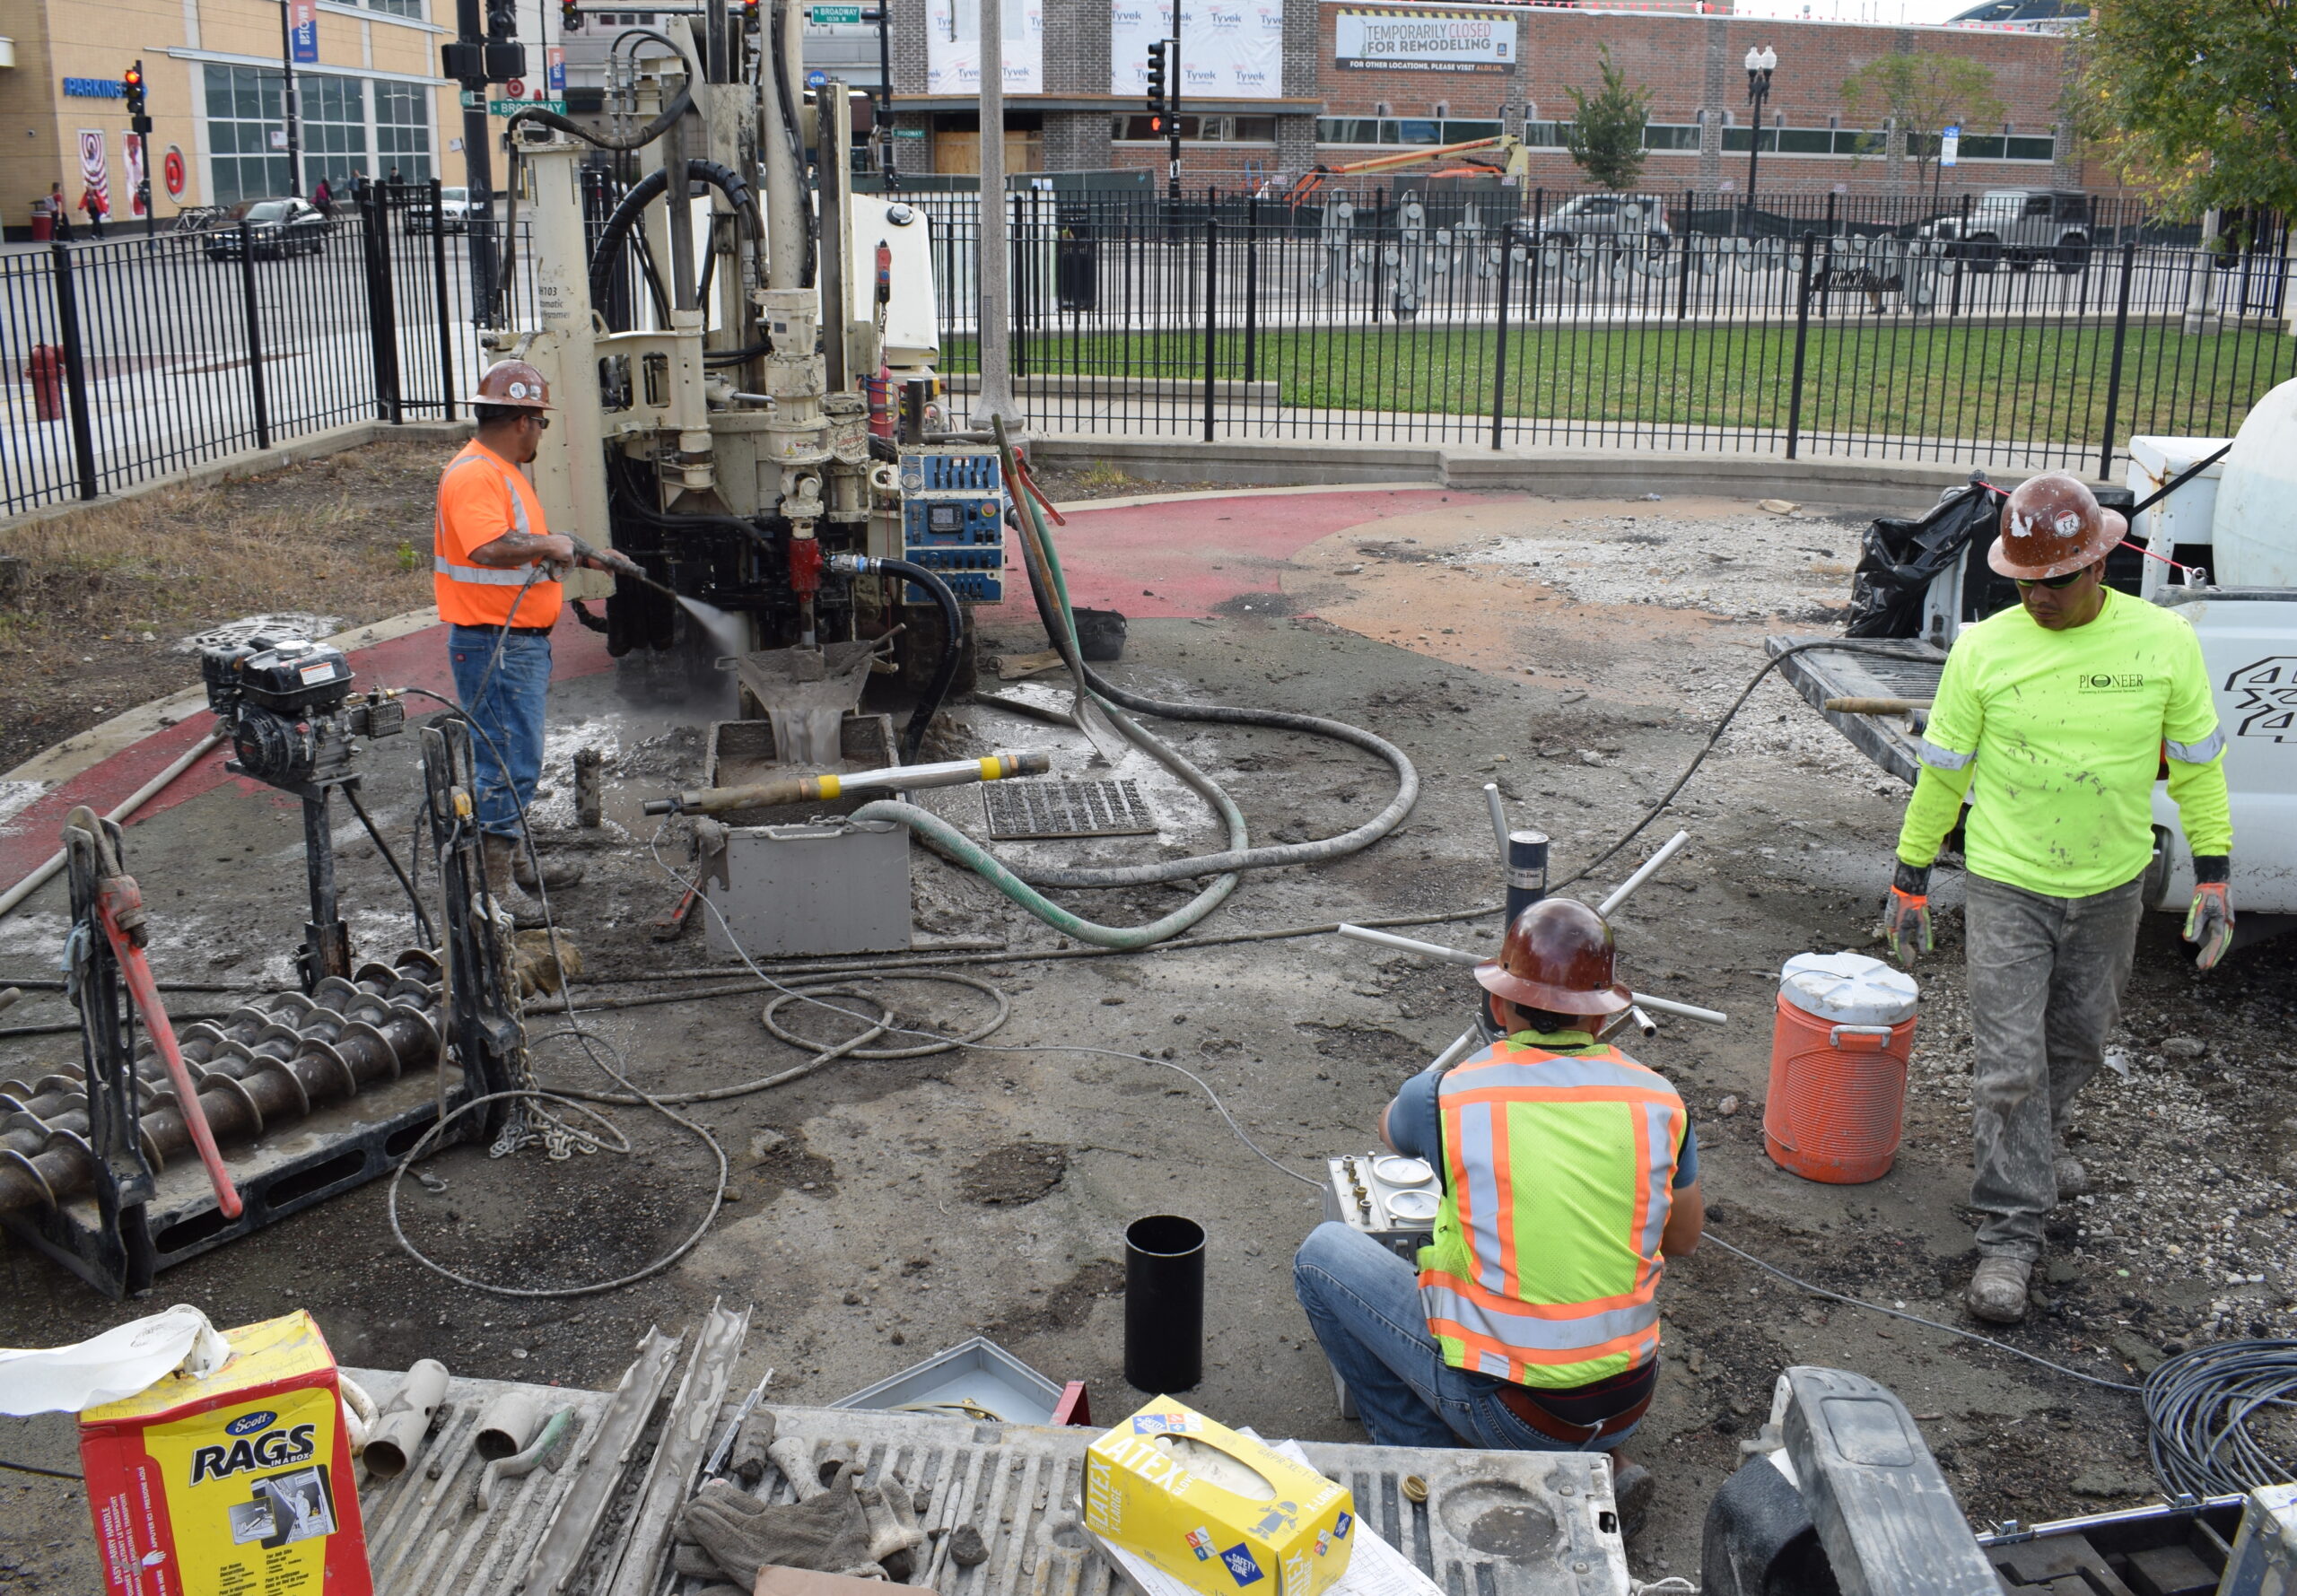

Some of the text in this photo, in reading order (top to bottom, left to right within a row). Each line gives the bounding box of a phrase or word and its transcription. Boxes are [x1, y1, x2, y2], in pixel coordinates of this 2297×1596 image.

[820, 7, 858, 16] BROADWAY
[1112, 11, 1141, 22] Tyvek
[1162, 12, 1192, 22] Tyek
[1212, 13, 1242, 23] Tyvek
[1367, 22, 1491, 40] TEMPORARILY CLOSED
[1367, 38, 1491, 53] FOR REMODELING
[1349, 60, 1364, 68] FOR
[1389, 62, 1429, 70] LOCATIONS,
[810, 75, 825, 83] cta
[1002, 67, 1030, 79] Tyvek
[1186, 70, 1216, 81] Tyvek
[1236, 71, 1265, 82] Tyvek
[64, 78, 124, 99] PARKING
[501, 102, 563, 114] BROWAY
[538, 285, 557, 296] H103
[2079, 674, 2144, 688] PIONEER
[235, 1412, 268, 1433] Scott
[189, 1423, 316, 1487] RAGS
[271, 1458, 282, 1467] IN
[292, 1453, 310, 1462] BOX
[1087, 1428, 1184, 1490] LATEX
[136, 1466, 147, 1481] AQUÍ
[141, 1481, 152, 1509] PRESIONE
[1089, 1456, 1112, 1529] LATEX
[1304, 1482, 1343, 1513] X-LARGE
[110, 1496, 122, 1531] TRANSPORT
[119, 1493, 131, 1527] TRANSPORTE
[146, 1513, 154, 1522] ICI
[1110, 1486, 1122, 1535] X-LARGE
[117, 1531, 124, 1539] LE
[147, 1522, 159, 1548] APPUYER
[101, 1506, 123, 1585] EASY ARRY HANDLE
[127, 1535, 137, 1562] FACILITAR
[118, 1539, 131, 1573] FCILITANT
[1232, 1553, 1256, 1573] SAFETY
[157, 1569, 165, 1584] HERE
[1231, 1561, 1248, 1577] ZONE
[1286, 1548, 1304, 1596] TEX
